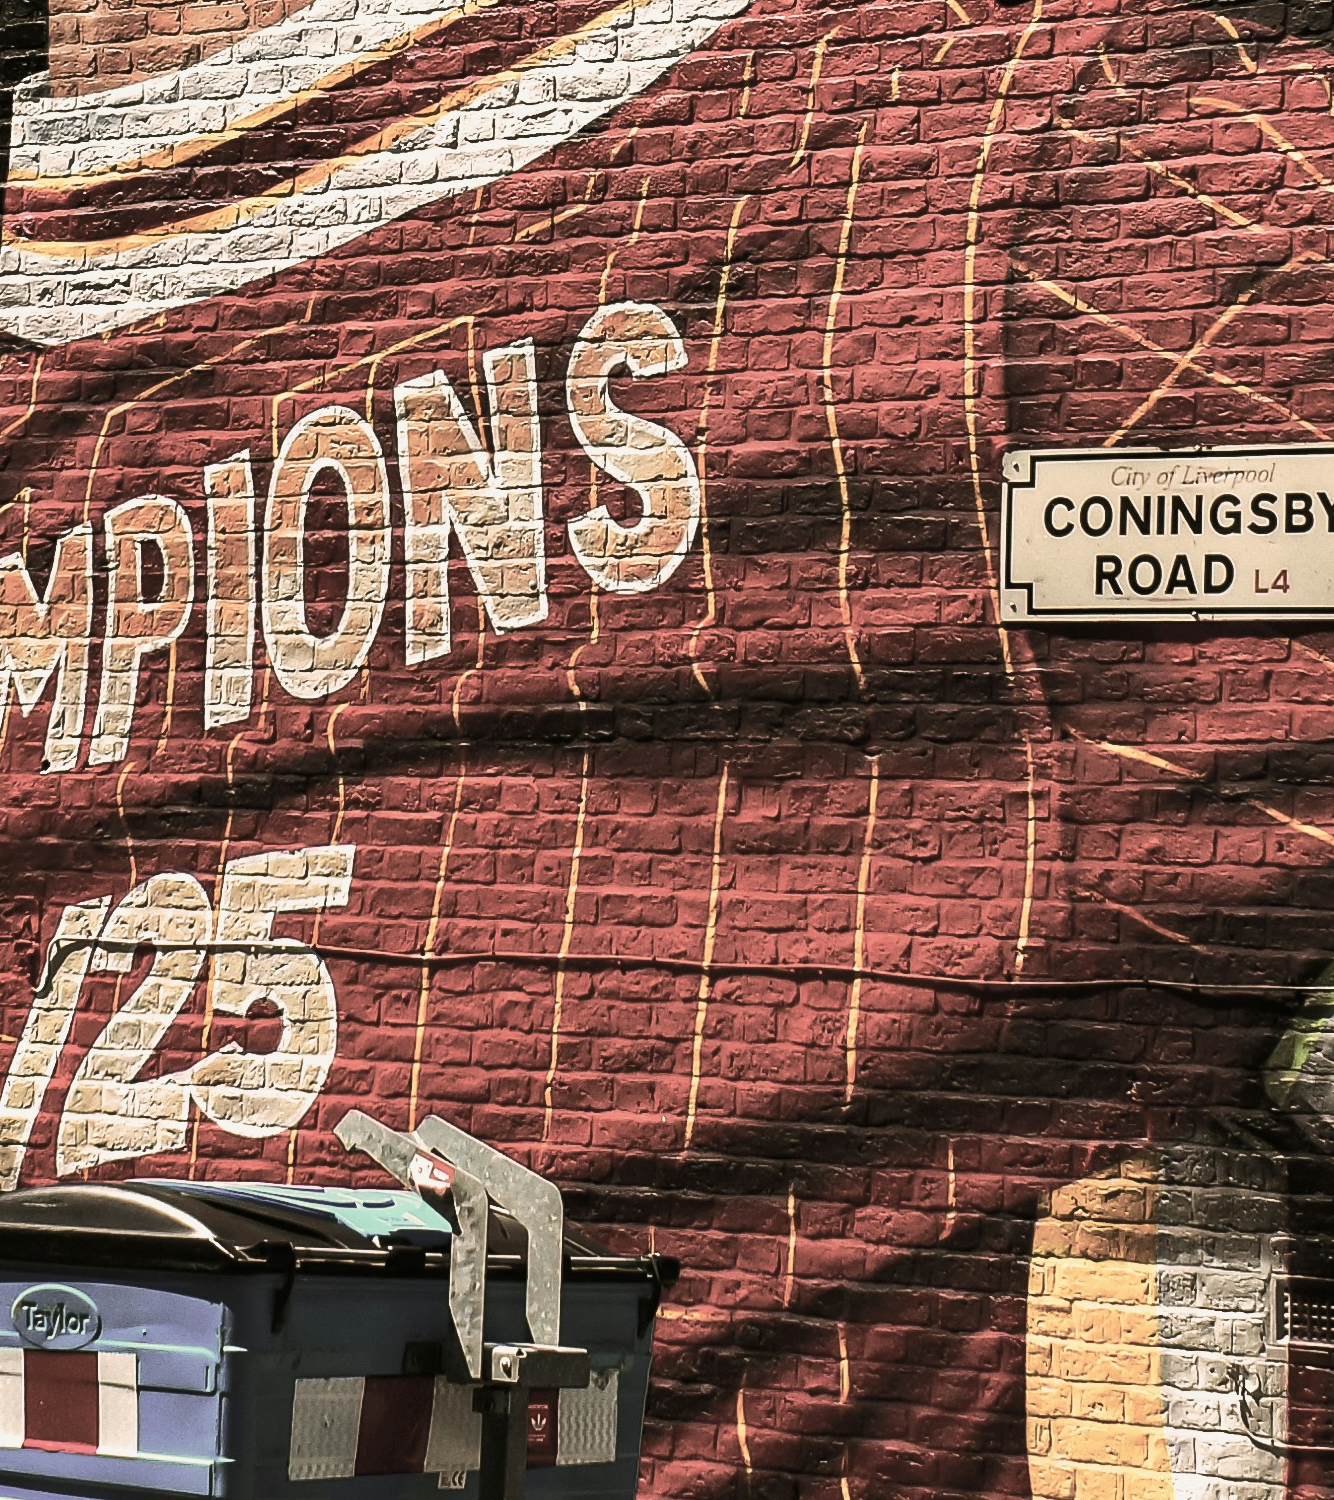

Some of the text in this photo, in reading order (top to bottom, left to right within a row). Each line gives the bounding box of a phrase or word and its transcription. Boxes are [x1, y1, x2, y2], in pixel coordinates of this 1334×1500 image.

[1111, 462, 1276, 490] City of Liverpool
[1094, 553, 1291, 596] ROAD L4
[20, 1301, 91, 1341] Taylor
